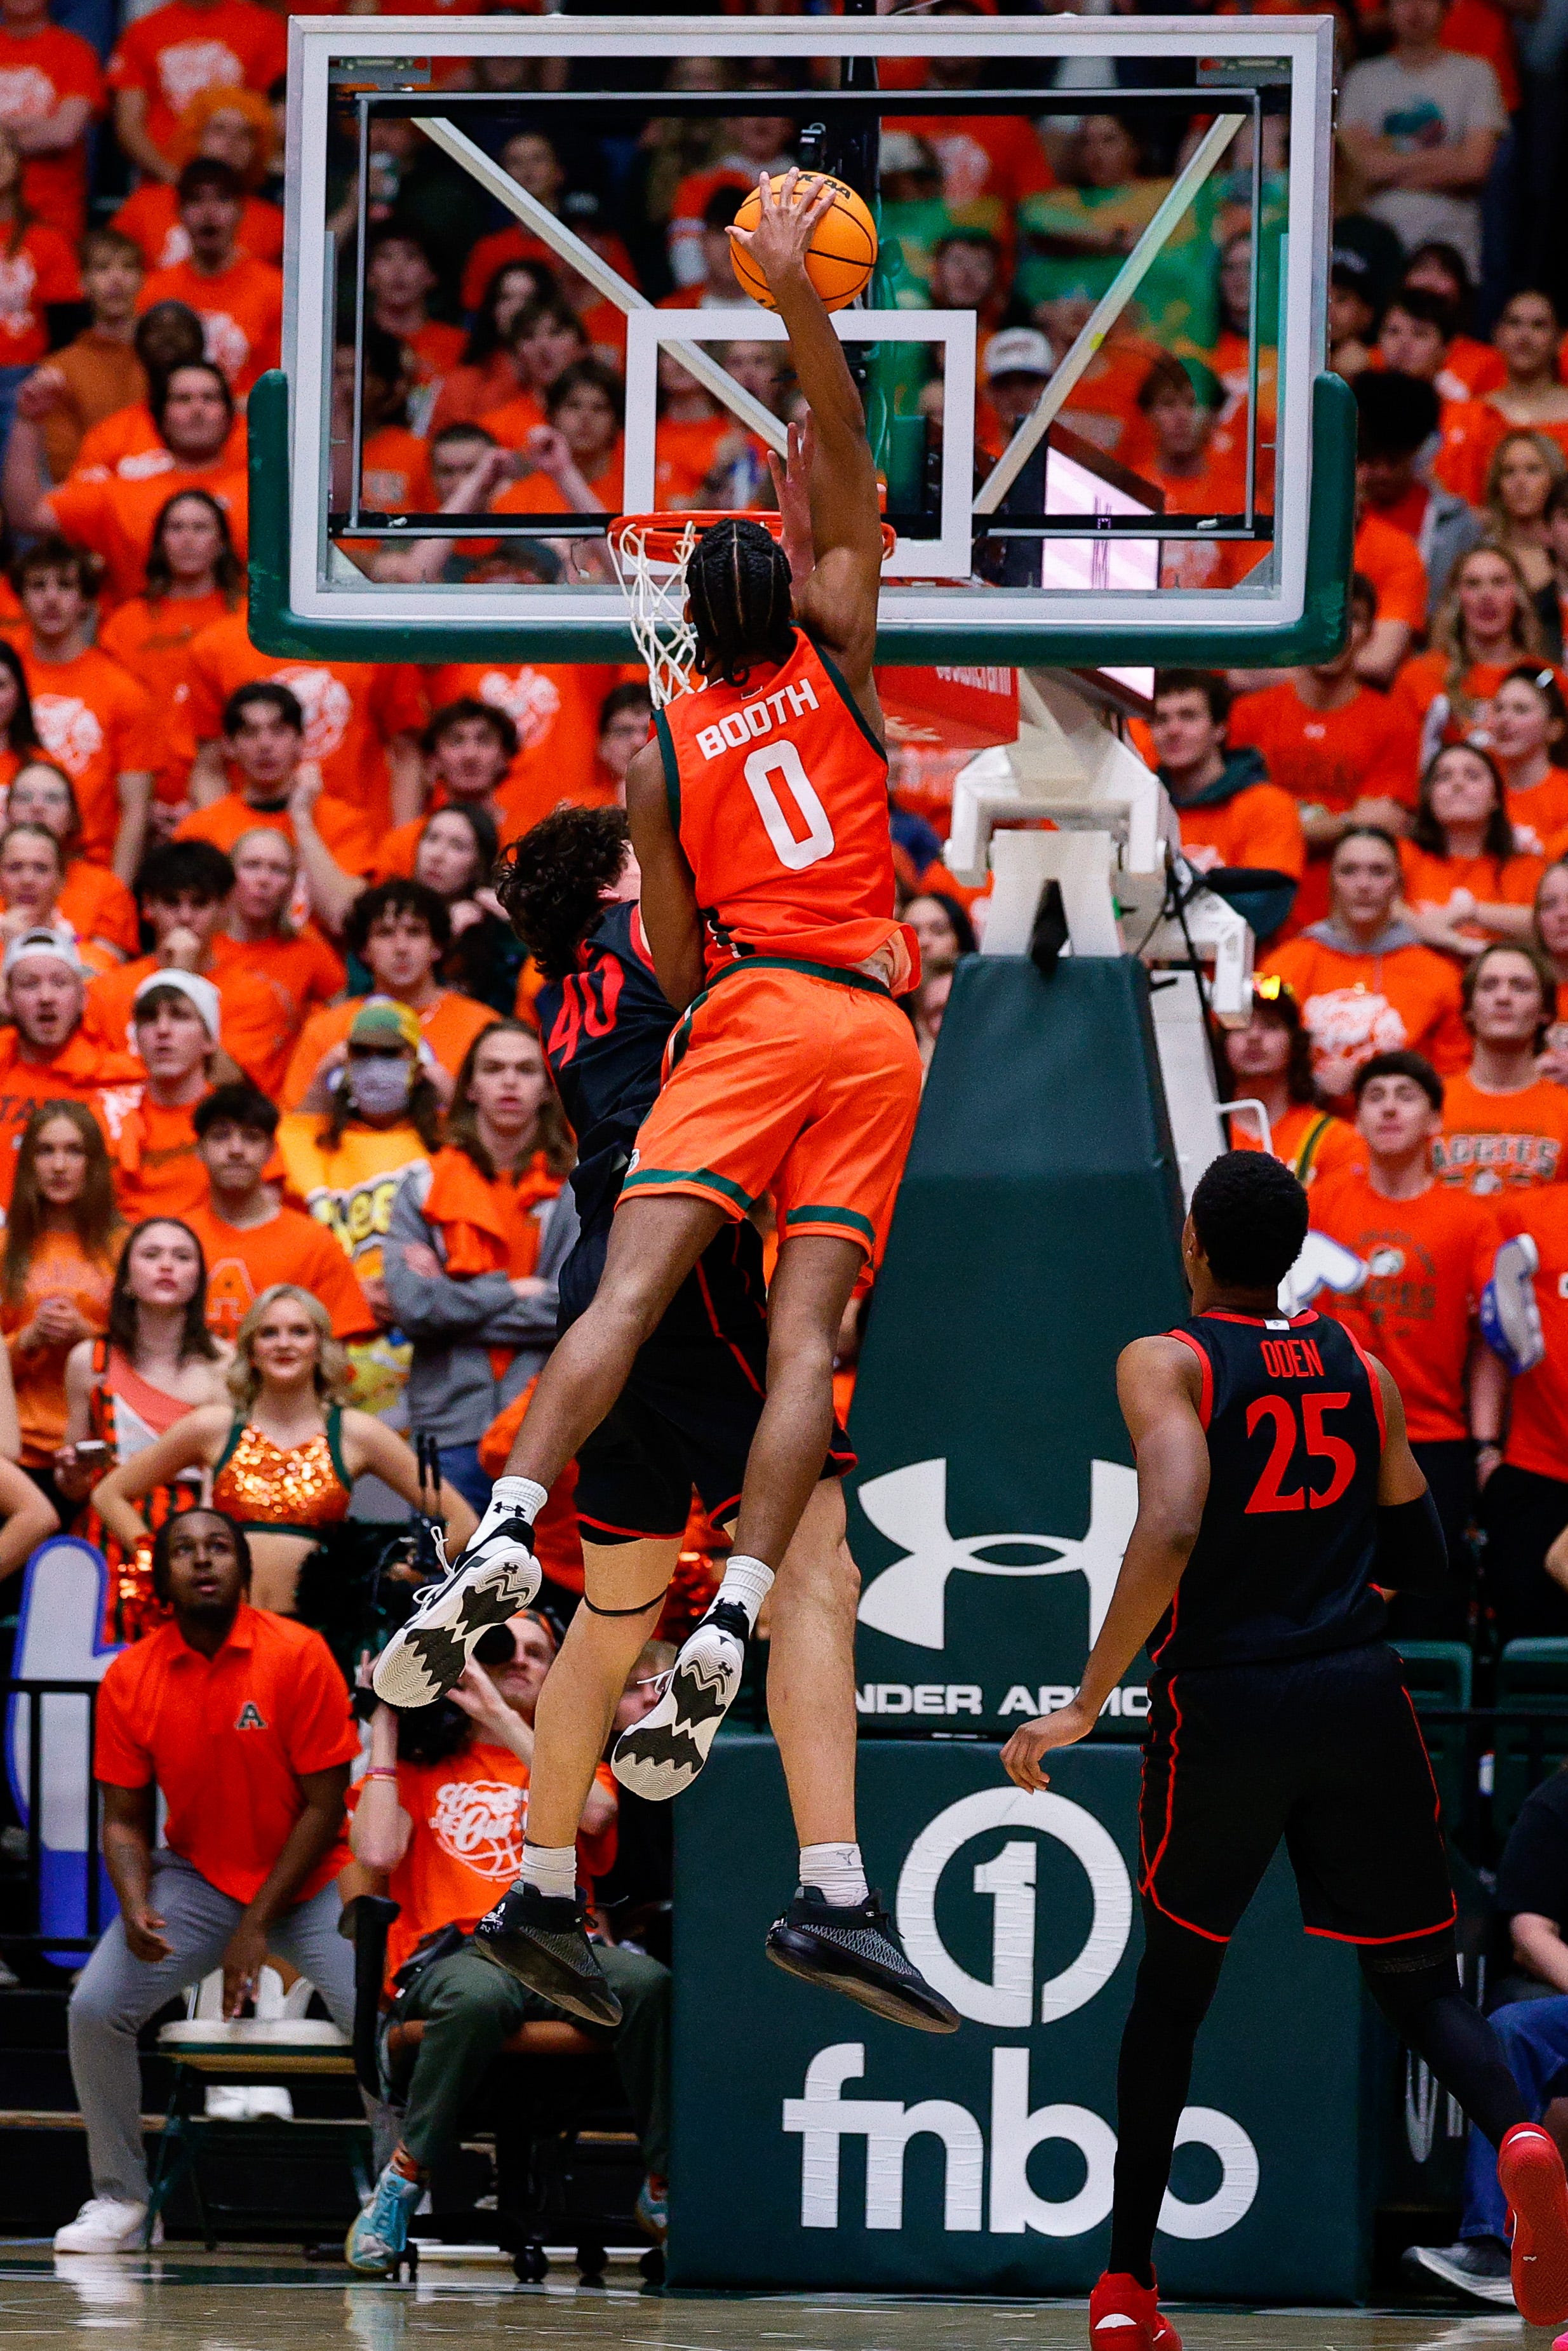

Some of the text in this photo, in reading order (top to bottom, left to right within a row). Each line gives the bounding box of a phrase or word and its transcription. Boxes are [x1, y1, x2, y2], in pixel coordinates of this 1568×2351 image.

[696, 678, 820, 761] BOOTH
[744, 739, 835, 870] 0
[547, 953, 626, 1070] 40
[1431, 1134, 1561, 1180] AGGIES
[1260, 1339, 1325, 1377] ODEN
[1244, 1393, 1357, 1513] 25
[234, 1701, 269, 1730] A
[855, 1684, 983, 1715] NDER
[782, 2042, 1260, 2240] fnbo
